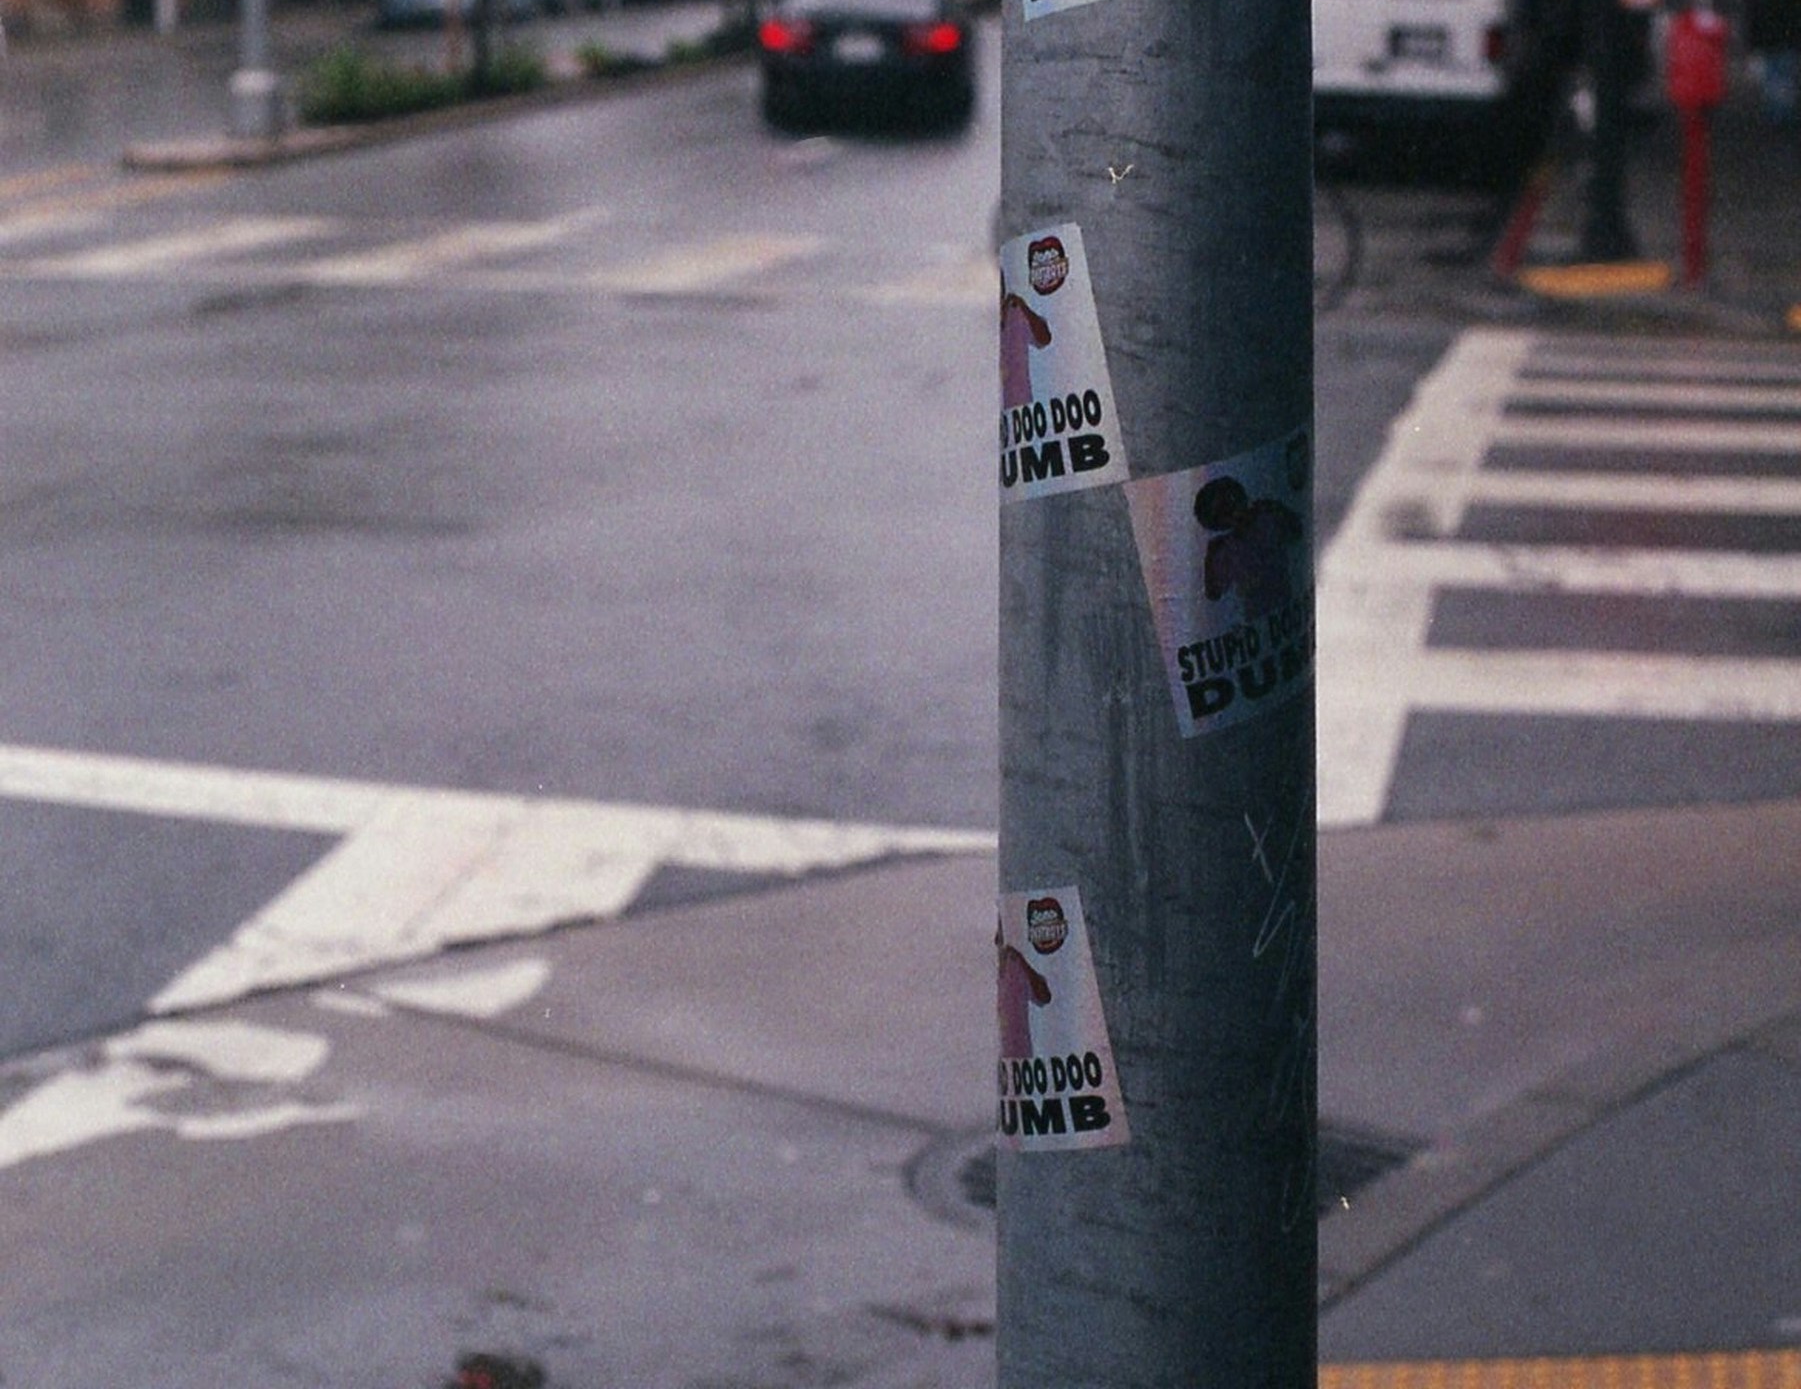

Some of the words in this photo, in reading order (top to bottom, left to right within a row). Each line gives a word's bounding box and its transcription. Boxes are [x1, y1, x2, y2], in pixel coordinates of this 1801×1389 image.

[1012, 402, 1047, 445] DOO
[1051, 389, 1101, 434] DOO
[1012, 1057, 1048, 1096] DOO
[1050, 1051, 1102, 1093] DOO
